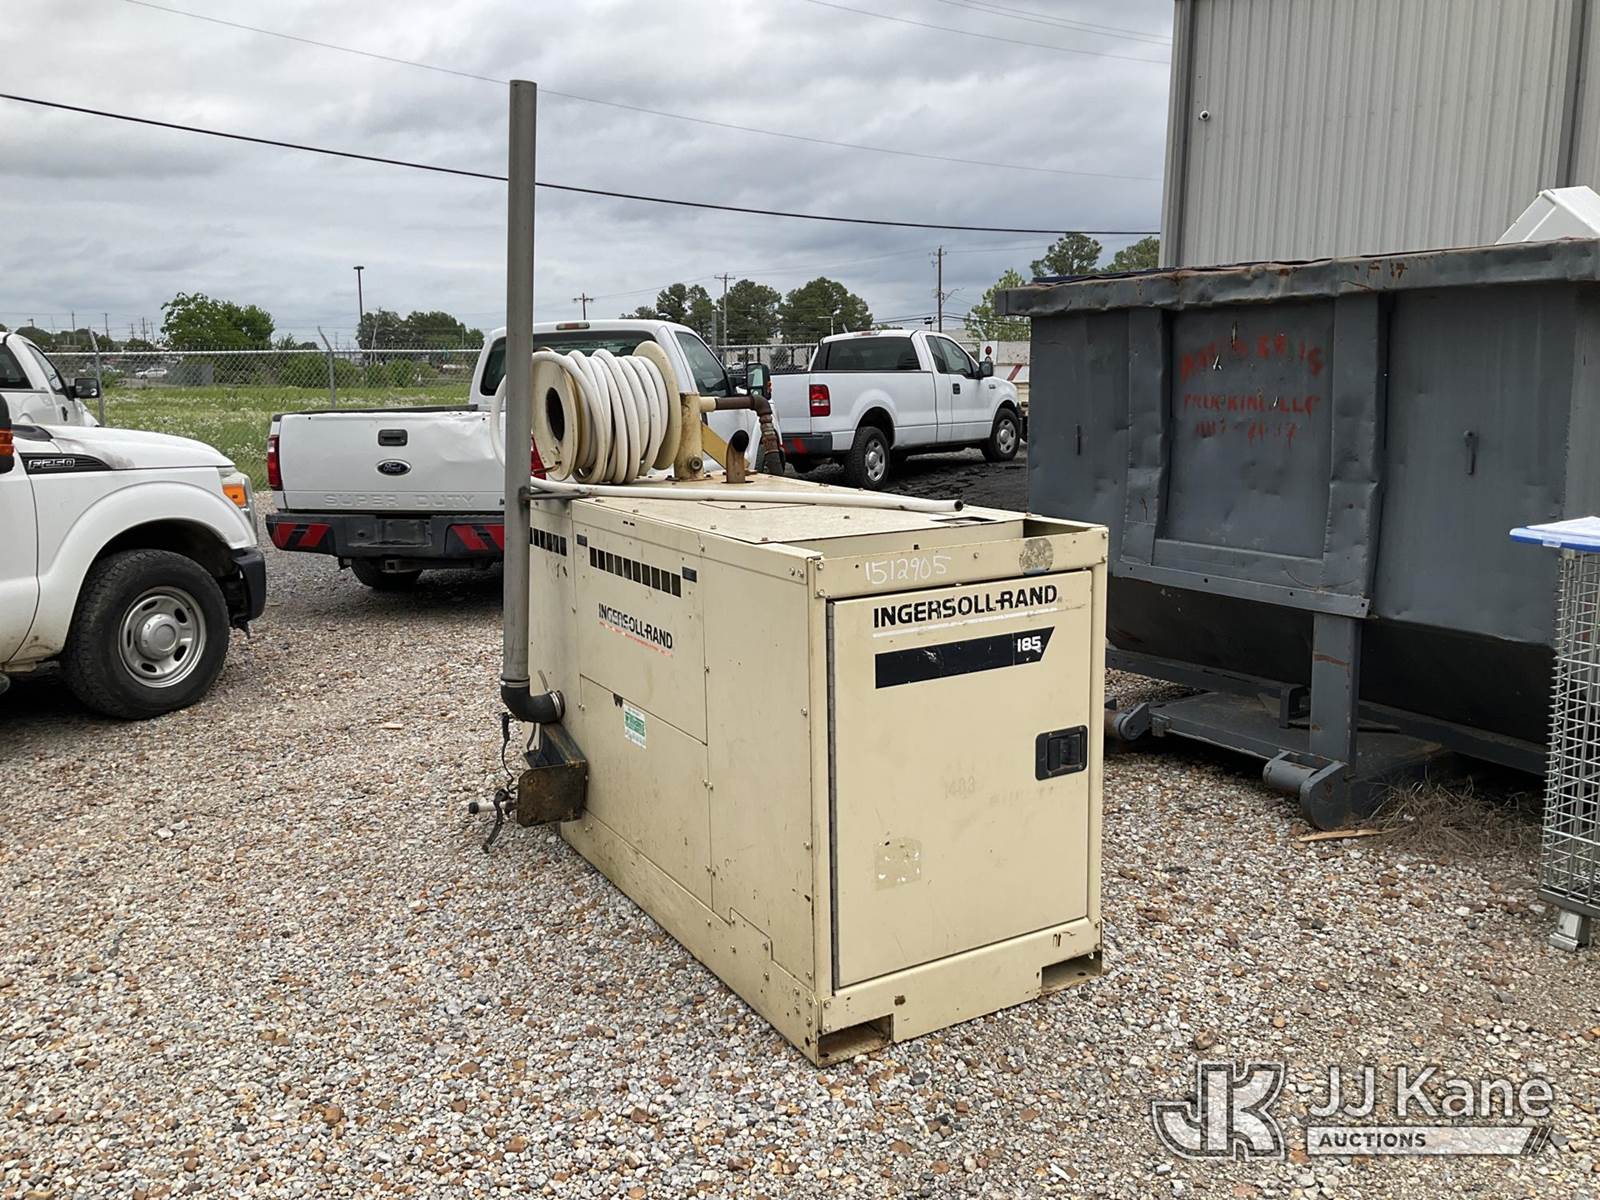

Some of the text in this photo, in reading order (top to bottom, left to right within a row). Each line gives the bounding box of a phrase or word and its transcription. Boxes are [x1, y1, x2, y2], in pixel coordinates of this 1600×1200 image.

[324, 494, 475, 507] SUPER DUTY
[864, 555, 951, 584] 1512905
[873, 584, 1058, 629] INGERSOLL-RAND
[598, 602, 673, 649] INGERSOLL-RAND
[1017, 635, 1042, 653] 185
